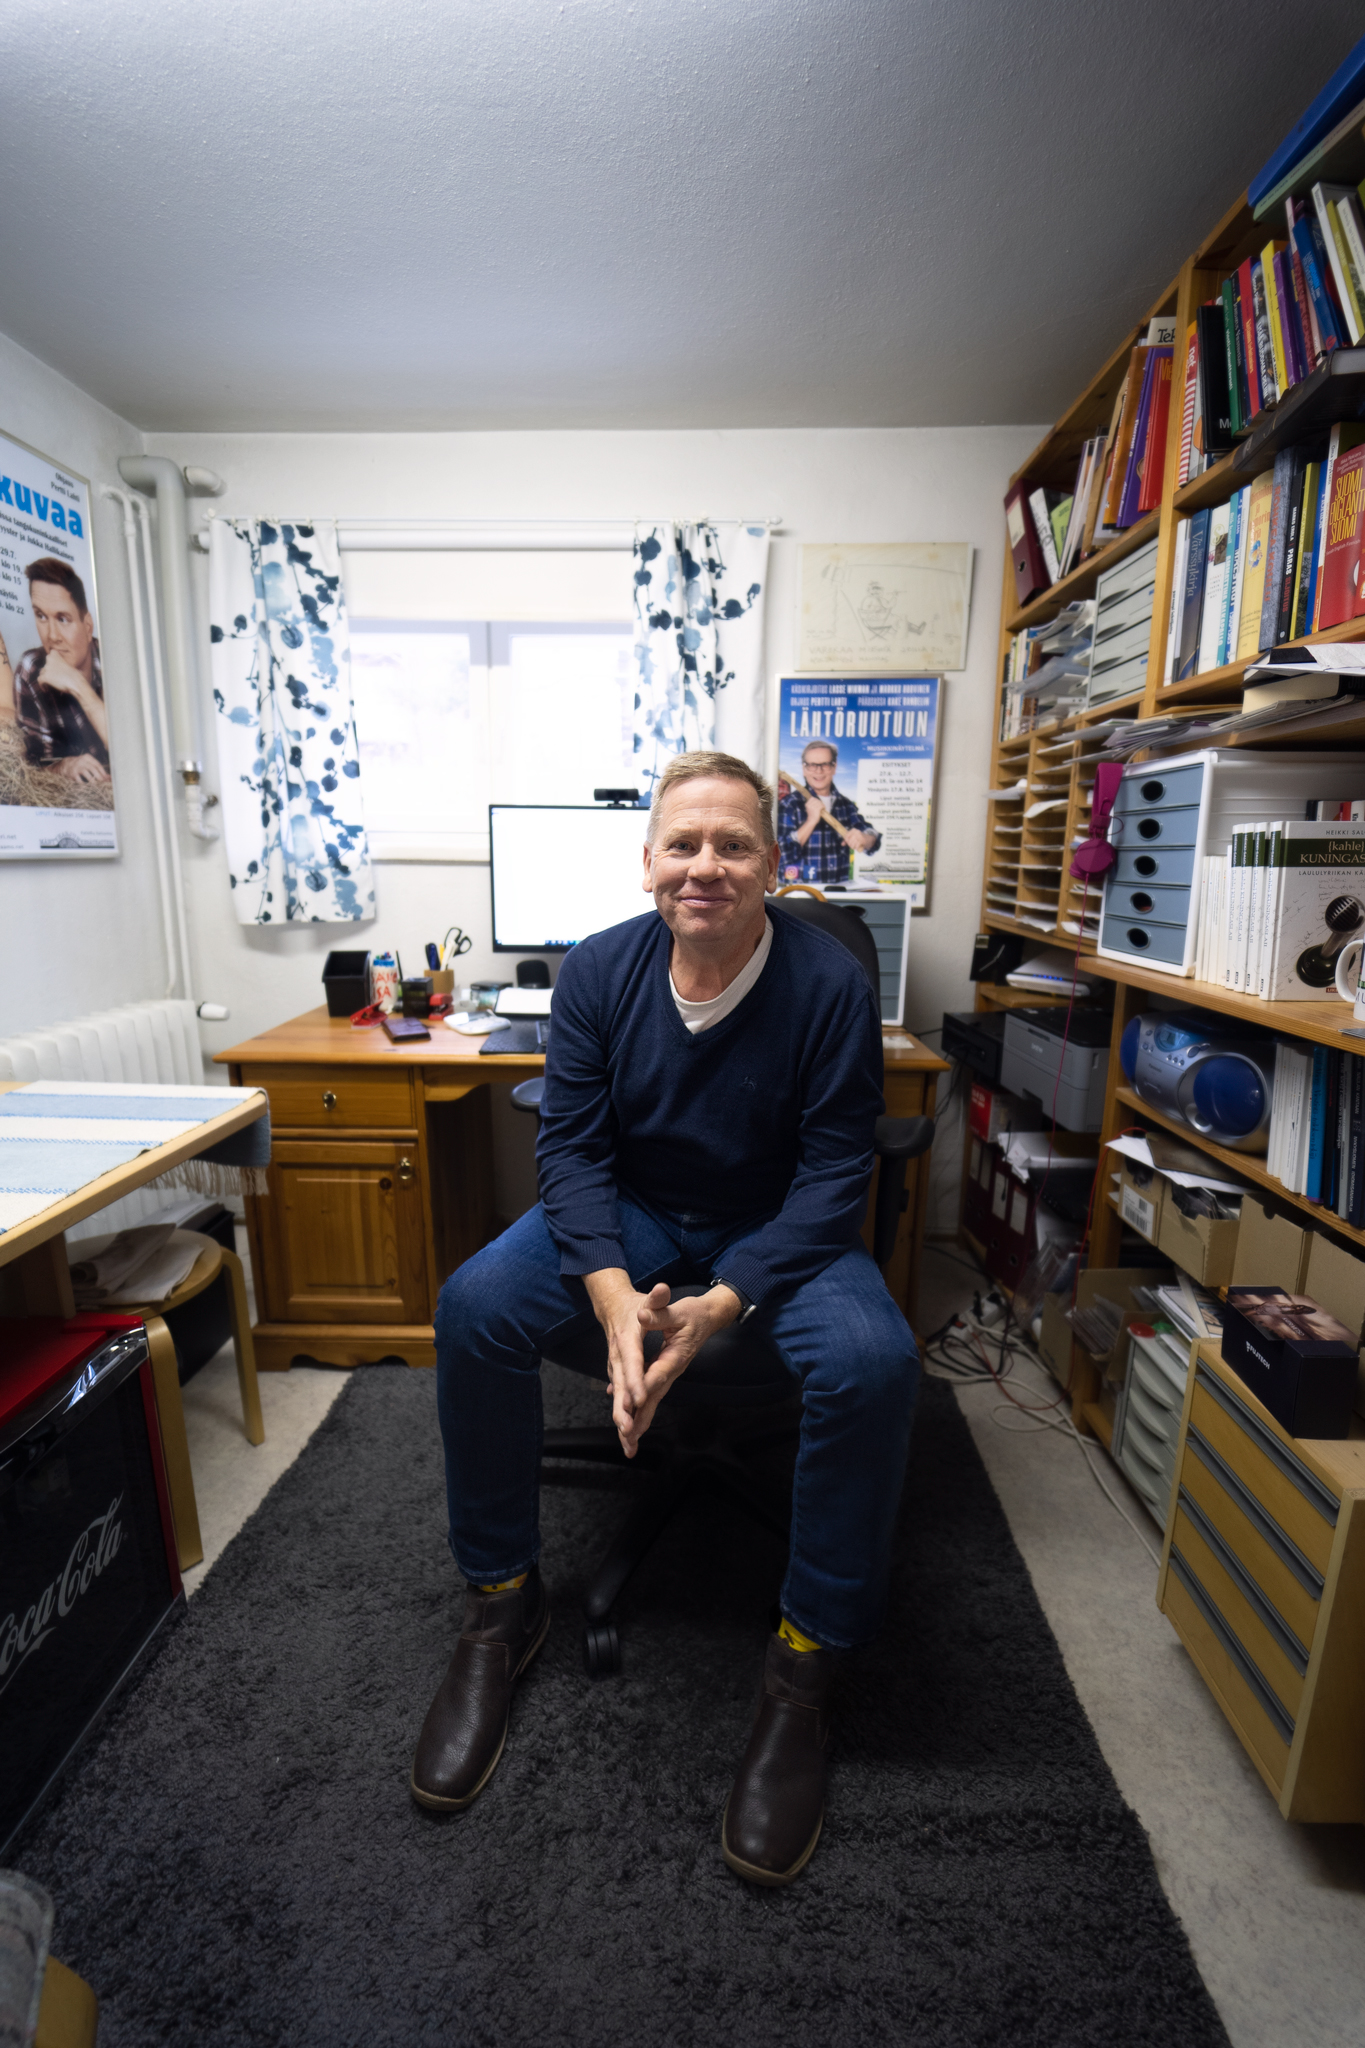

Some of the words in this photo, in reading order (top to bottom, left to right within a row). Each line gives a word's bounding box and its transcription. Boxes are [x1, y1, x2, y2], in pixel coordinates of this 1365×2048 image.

[1219, 418, 1232, 428] M
[1335, 467, 1363, 500] SUOMI
[0, 475, 84, 540] kuvaa
[1330, 514, 1357, 546] SUOMI
[1, 559, 11, 569] klo
[1186, 528, 1204, 598] Värssykirja
[1285, 547, 1294, 576] PARAS
[1, 571, 11, 582] klo
[13, 577, 22, 586] 15
[16, 606, 25, 616] 22
[790, 707, 929, 738] LÄHTÖRUUTUUN
[1328, 841, 1365, 853] {kahle}
[1300, 853, 1365, 864] KUNINGAS
